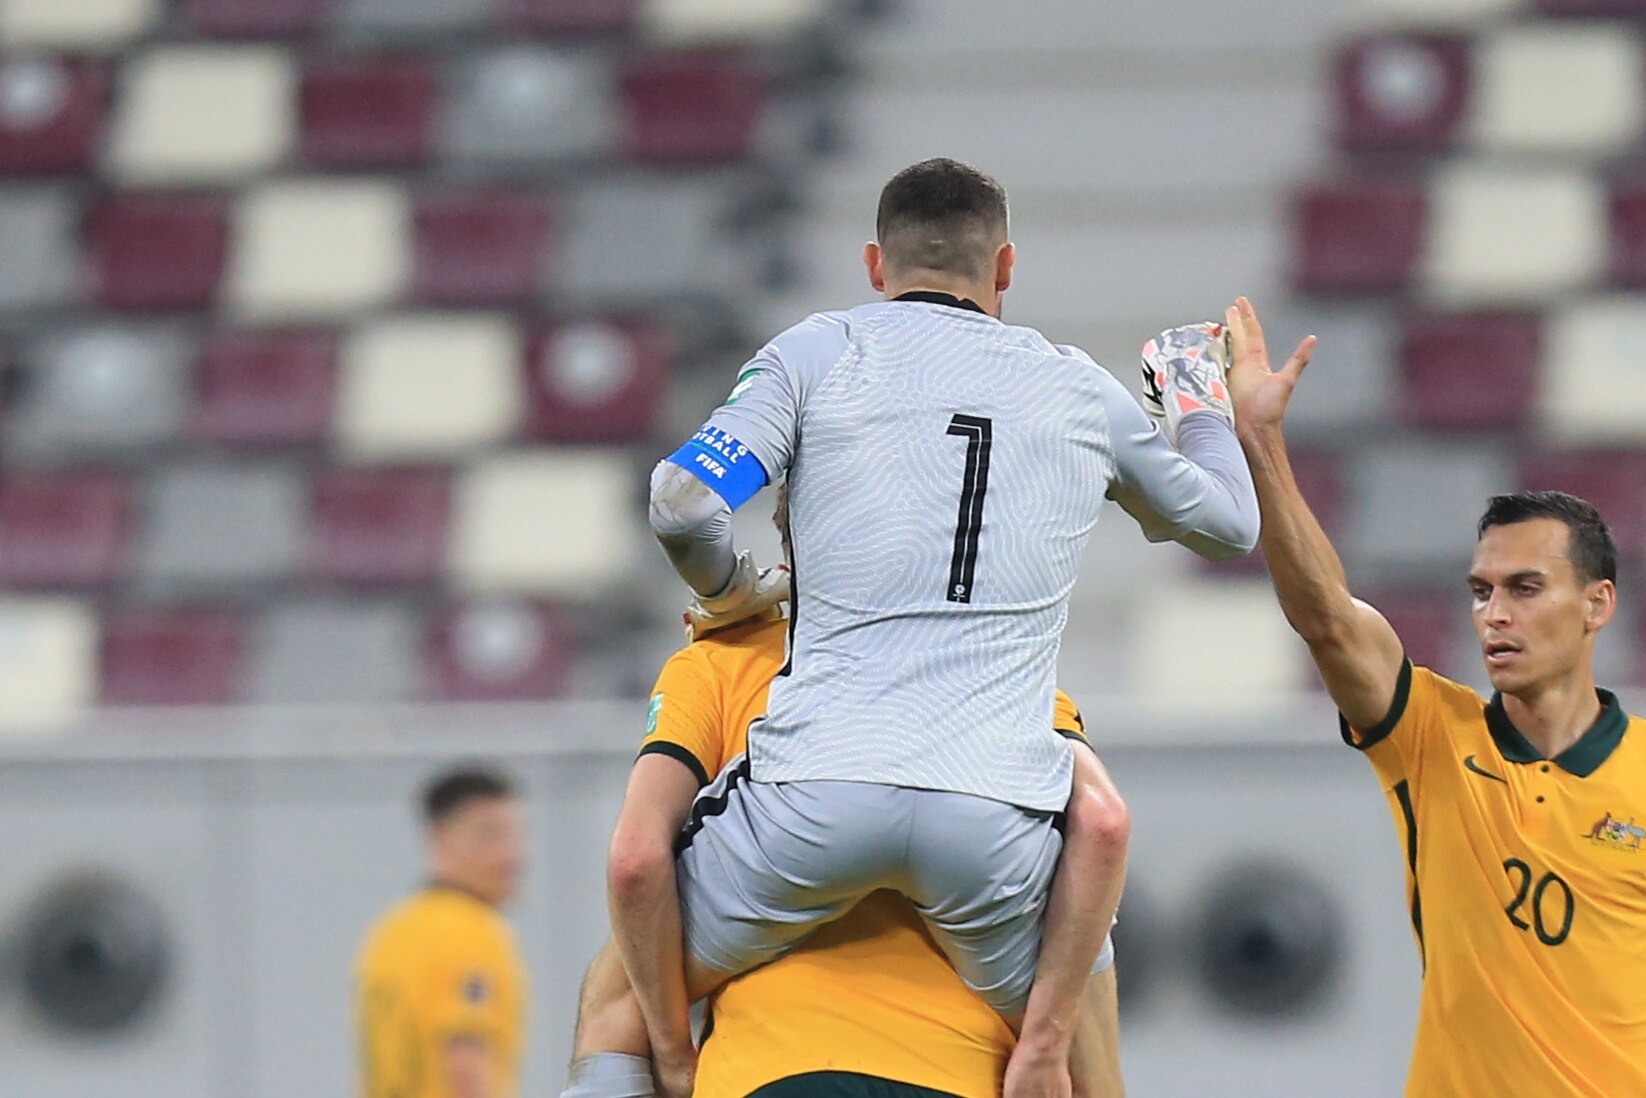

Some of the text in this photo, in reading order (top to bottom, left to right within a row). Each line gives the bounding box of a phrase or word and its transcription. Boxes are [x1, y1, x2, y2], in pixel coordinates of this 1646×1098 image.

[692, 432, 738, 464] TBALL
[694, 452, 726, 479] FIFA
[945, 412, 993, 604] 1
[1502, 857, 1575, 946] 20
